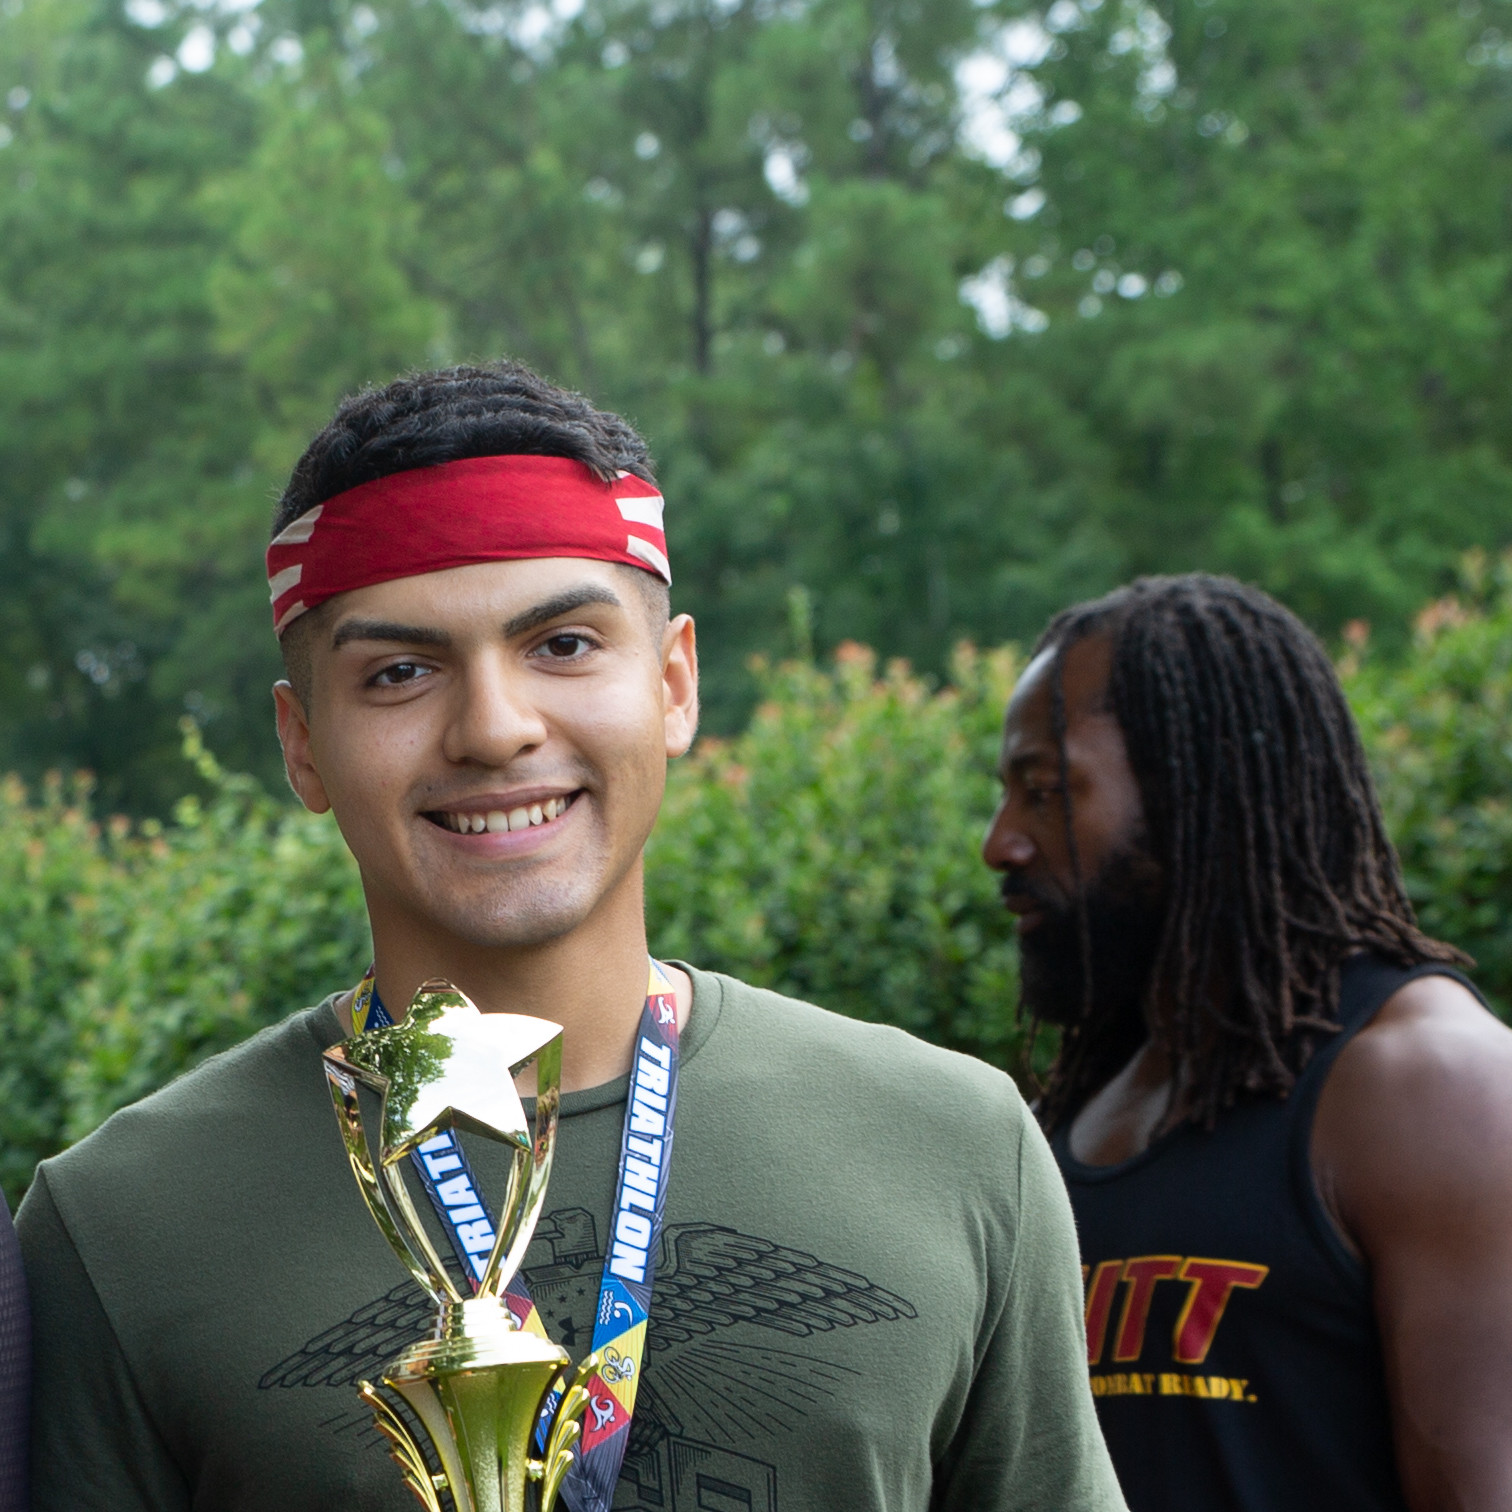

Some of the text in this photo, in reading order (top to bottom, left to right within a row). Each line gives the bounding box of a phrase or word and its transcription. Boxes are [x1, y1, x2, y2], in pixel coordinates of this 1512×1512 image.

[609, 1035, 673, 1285] TRIATHLON
[1081, 1254, 1270, 1365] ITT
[1090, 1372, 1156, 1398] OMBAT
